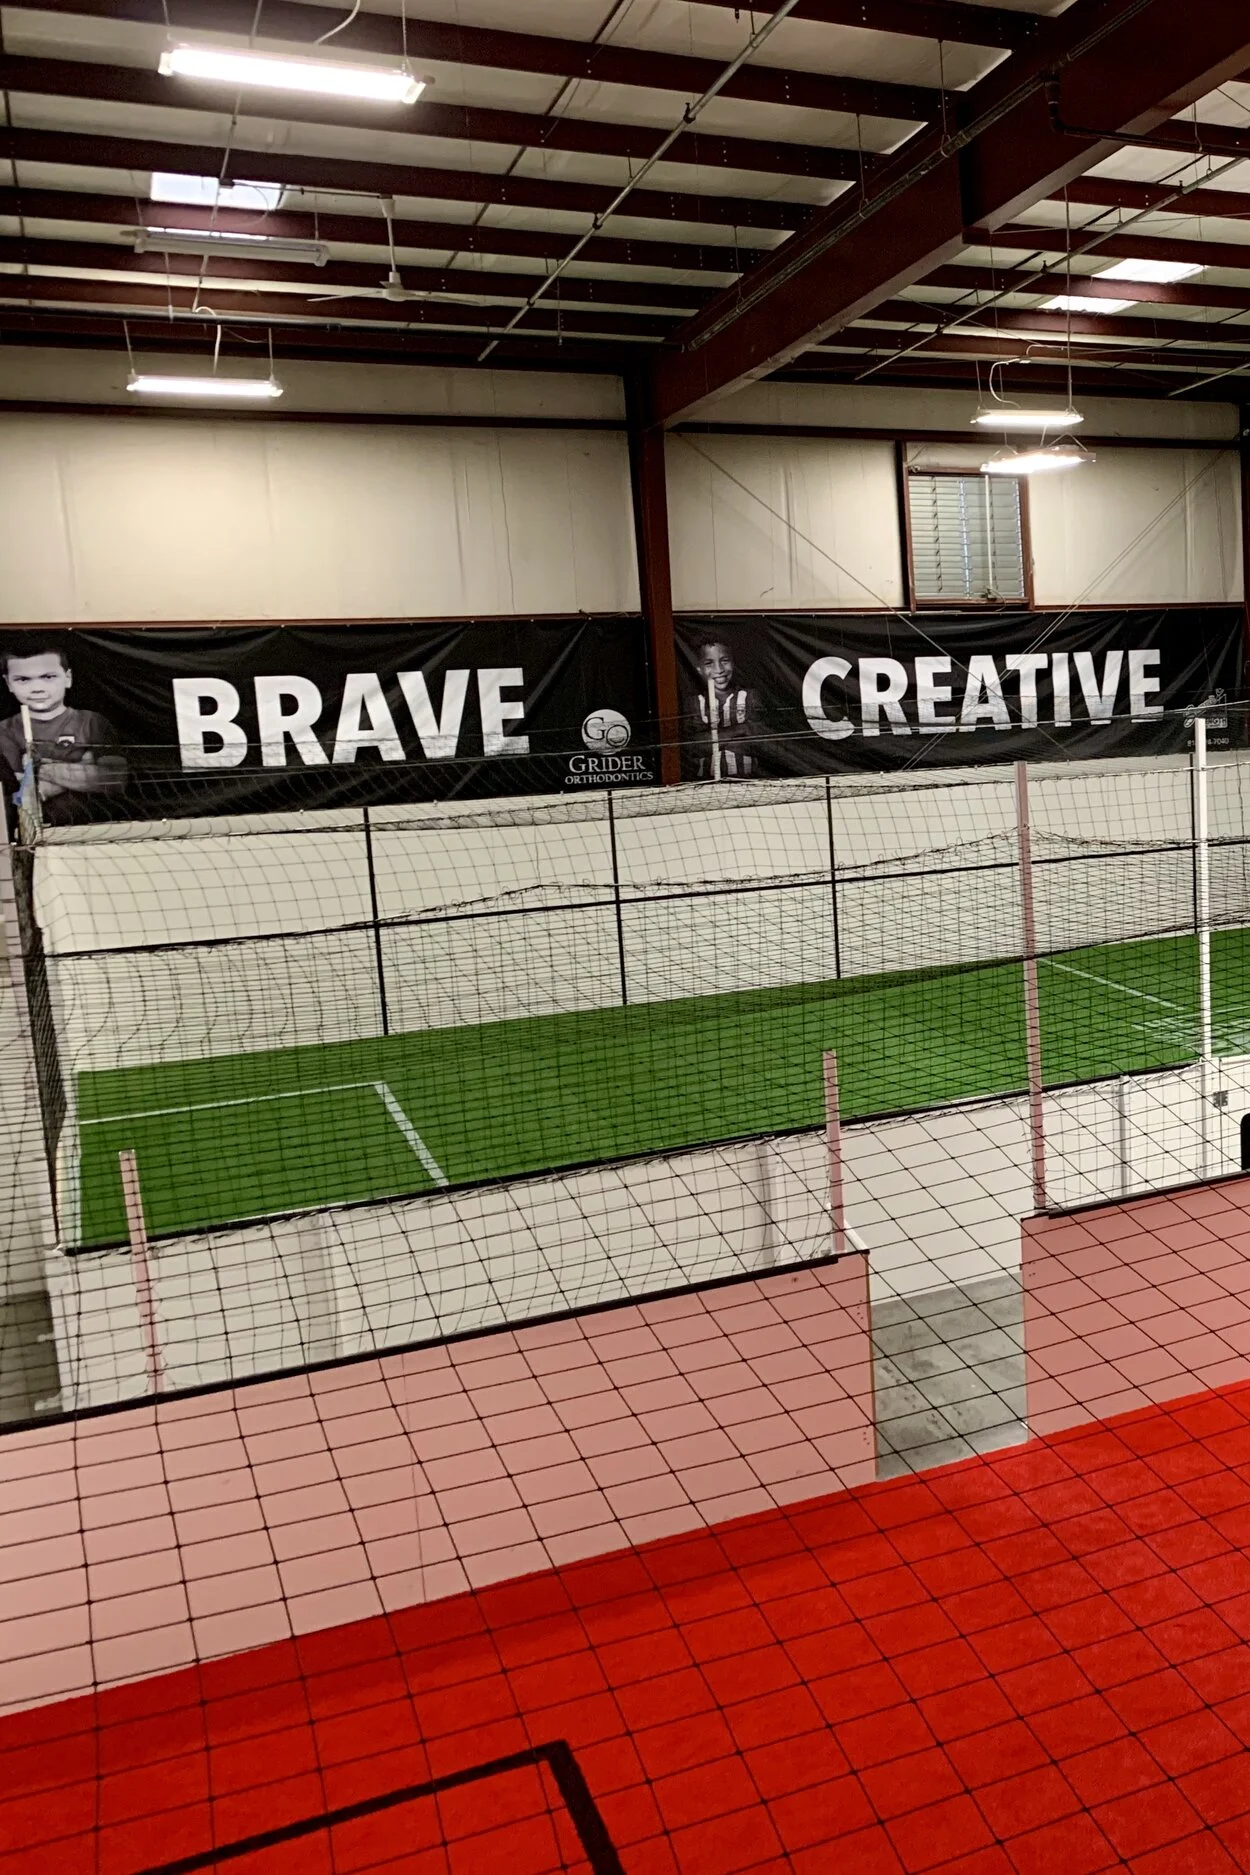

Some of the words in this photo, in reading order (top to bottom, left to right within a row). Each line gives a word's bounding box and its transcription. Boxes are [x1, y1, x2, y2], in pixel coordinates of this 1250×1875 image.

[172, 667, 531, 773] BRAVE
[801, 648, 1164, 740] CREATIVE
[564, 771, 654, 785] ORTHODONTICS
[568, 755, 646, 773] GRIDER
